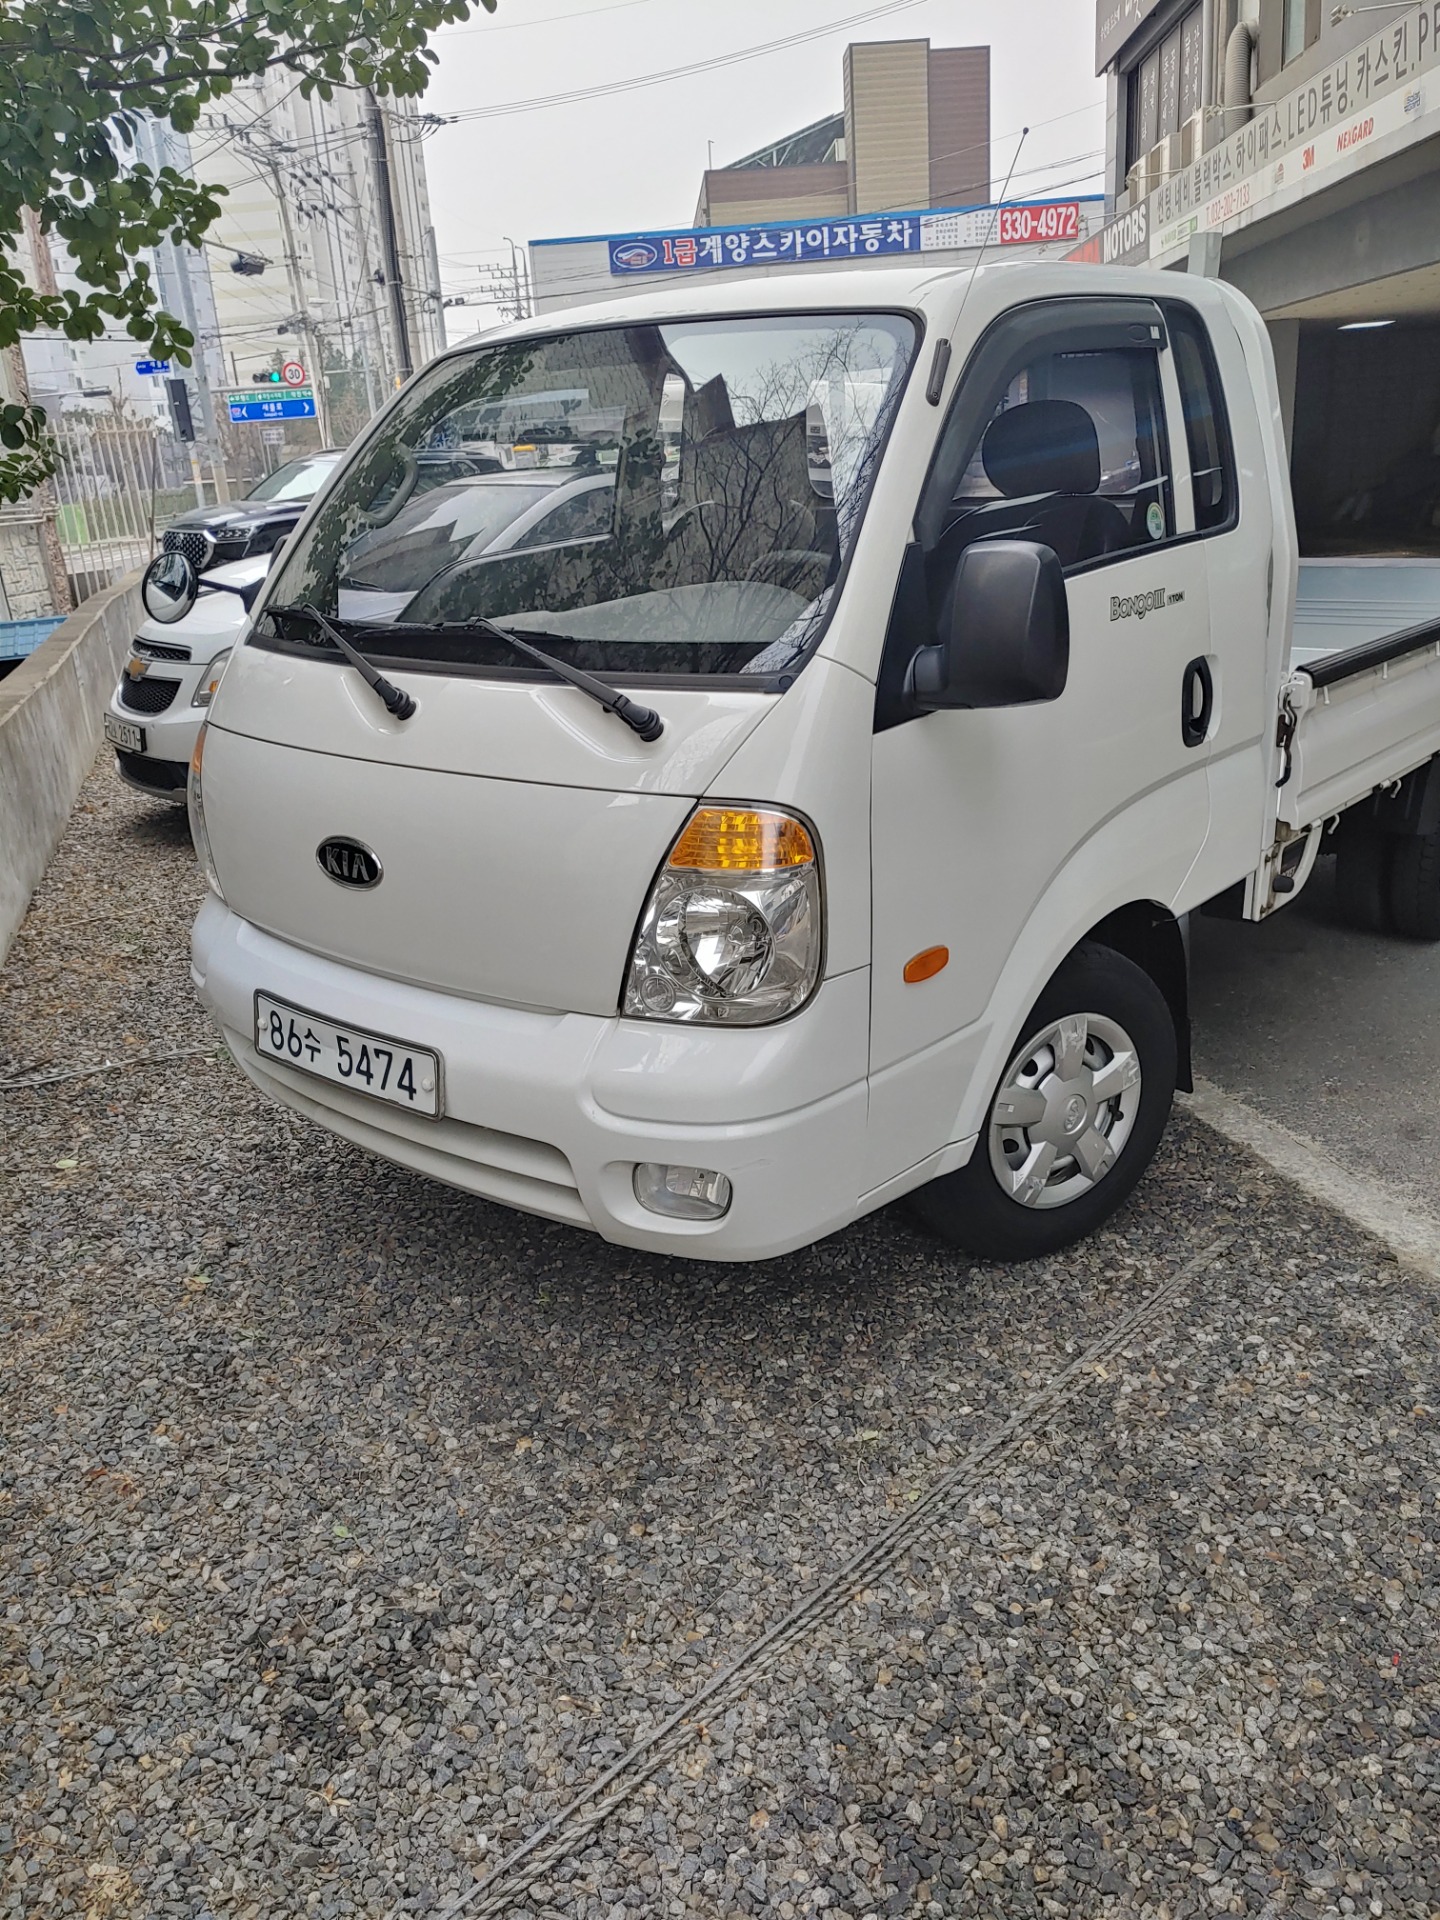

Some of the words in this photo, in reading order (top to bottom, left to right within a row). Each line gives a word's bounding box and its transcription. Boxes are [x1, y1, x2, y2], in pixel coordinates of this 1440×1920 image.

[1303, 144, 1314, 170] 3M
[1002, 206, 1077, 241] 330-4972
[1104, 204, 1146, 264] MOTORS
[288, 369, 301, 380] 30
[325, 846, 370, 881] KIA
[270, 1010, 321, 1062] 86수
[335, 1034, 417, 1101] 5474
